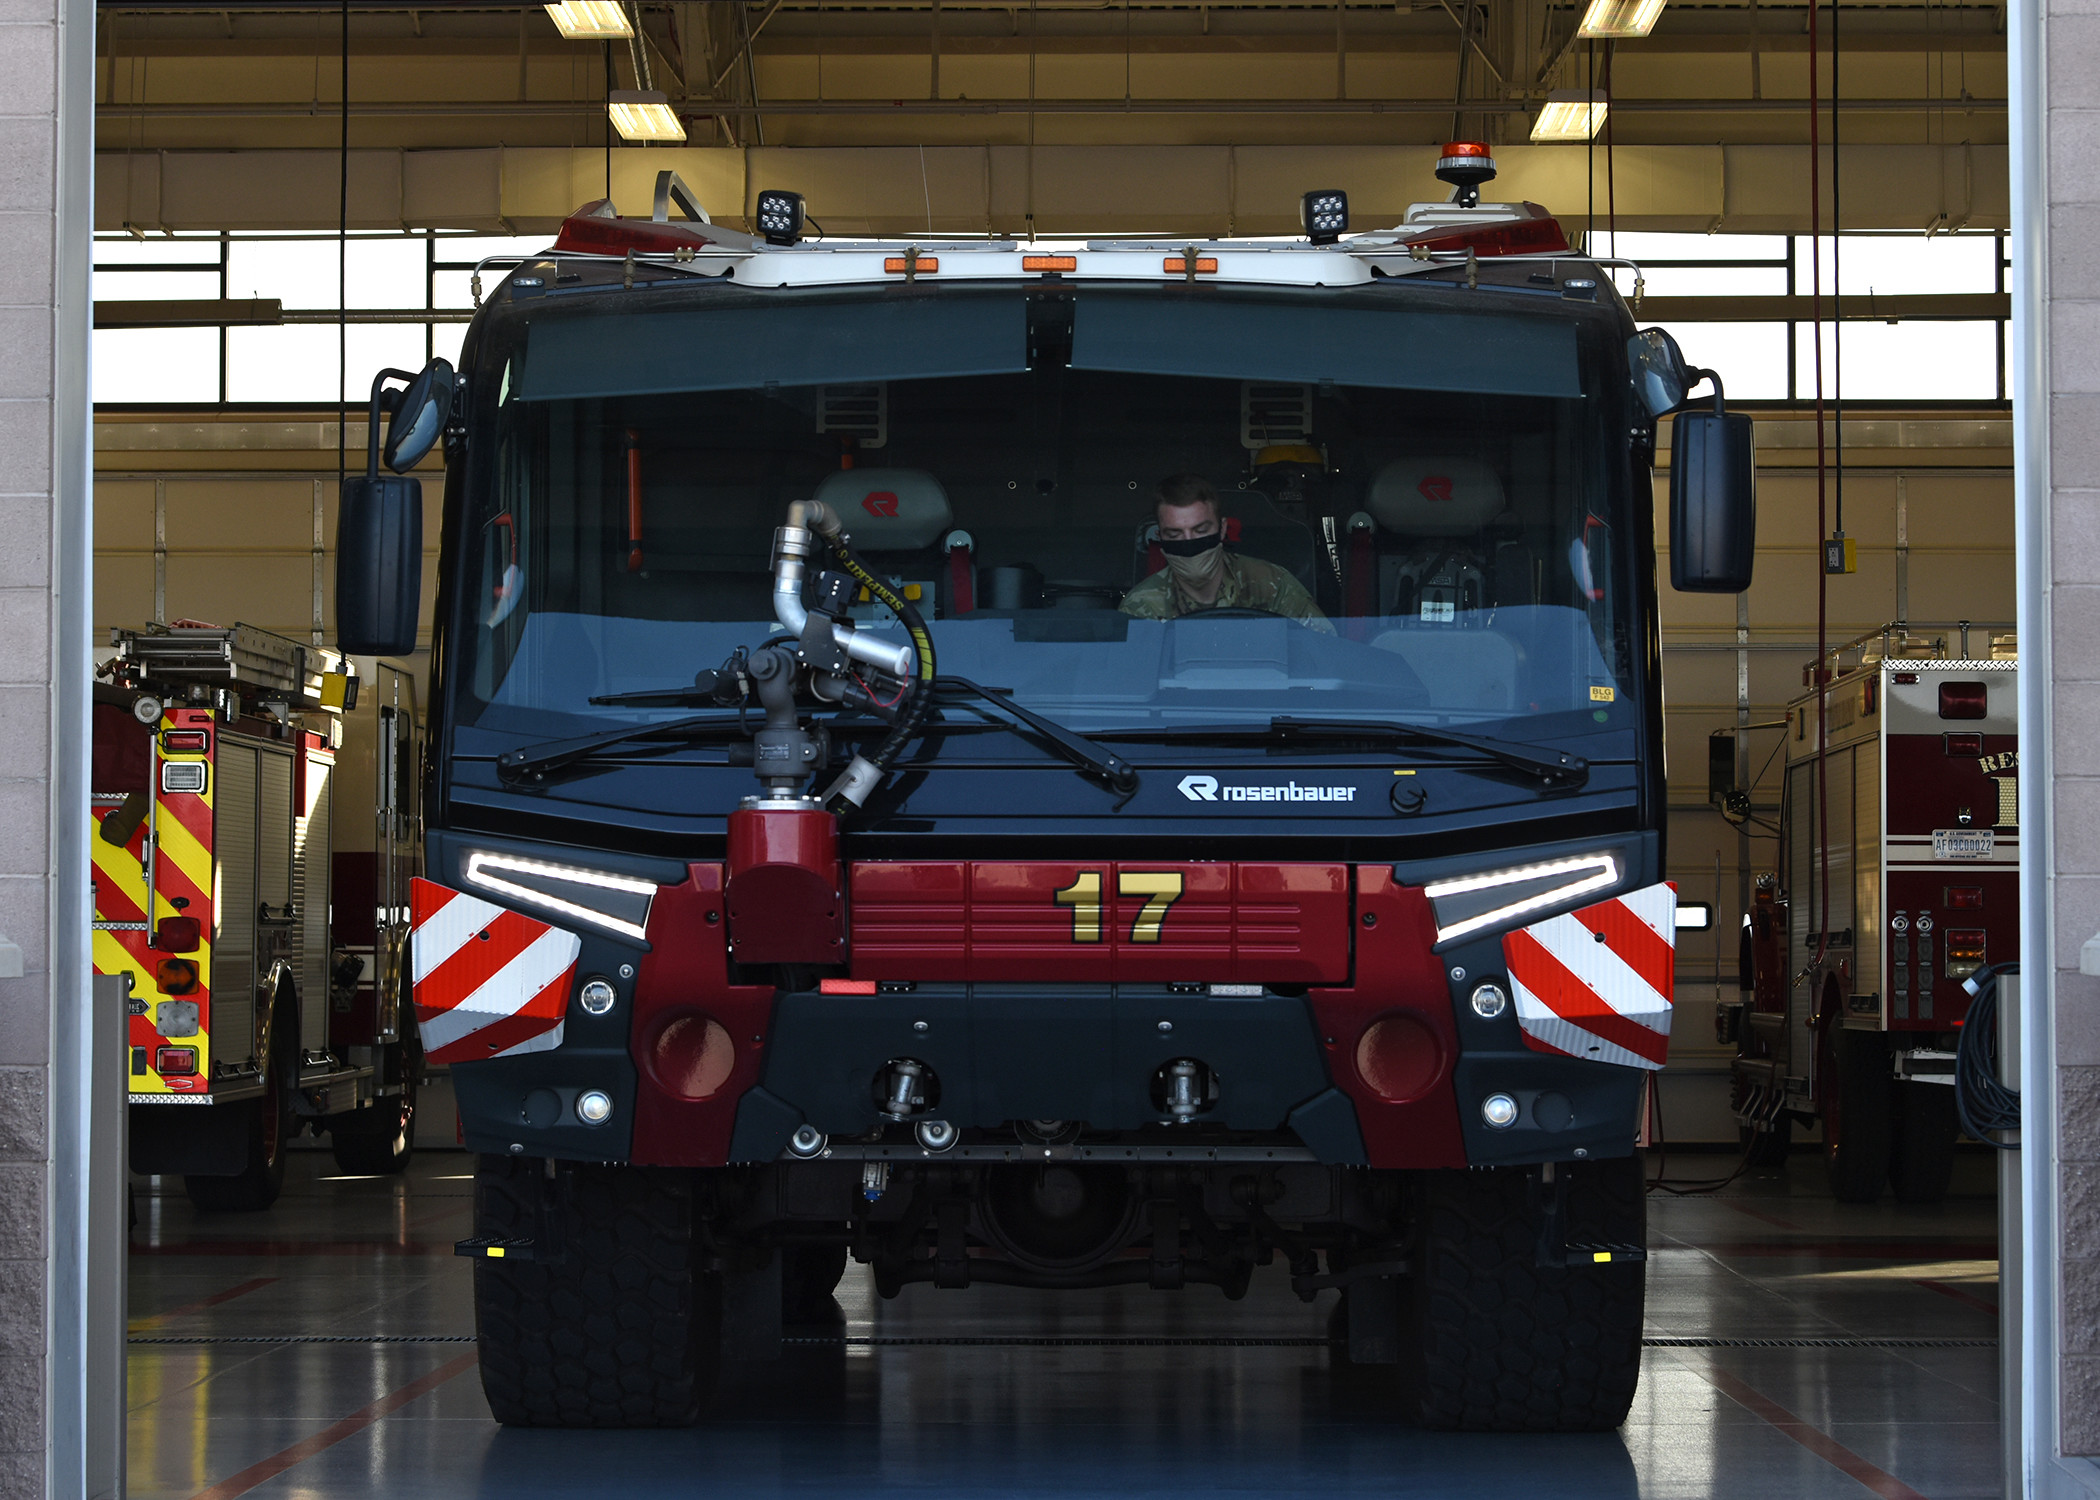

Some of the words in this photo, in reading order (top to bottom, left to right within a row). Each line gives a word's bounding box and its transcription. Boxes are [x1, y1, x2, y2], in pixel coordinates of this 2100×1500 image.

[844, 560, 904, 611] SEMPERIT
[1223, 781, 1356, 801] rosenbauer
[1054, 871, 1184, 944] 17
